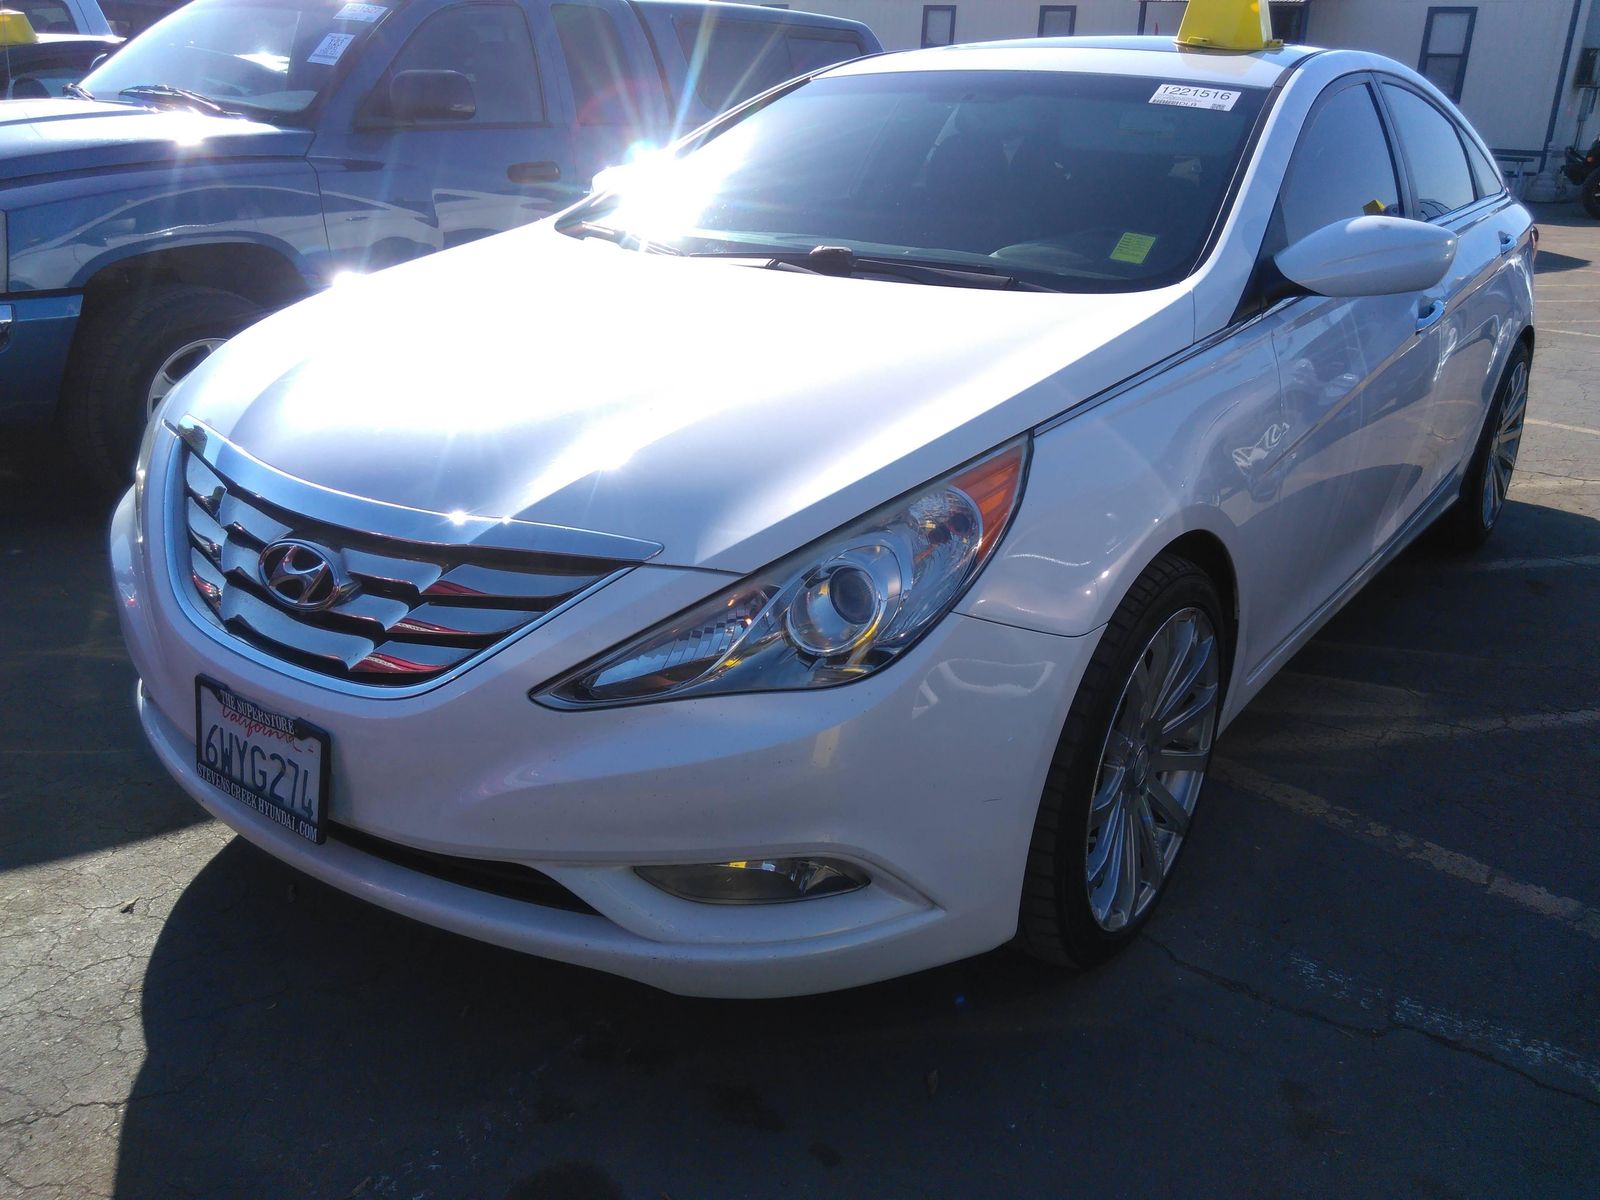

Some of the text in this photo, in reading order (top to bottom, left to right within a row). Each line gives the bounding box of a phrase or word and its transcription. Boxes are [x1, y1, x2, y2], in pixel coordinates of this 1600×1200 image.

[1162, 86, 1232, 100] 1221516
[221, 690, 295, 735] THE SUPERSTORE
[197, 762, 230, 795] STEVENS
[231, 781, 257, 809] CREEK
[205, 724, 314, 820] 6WYG274
